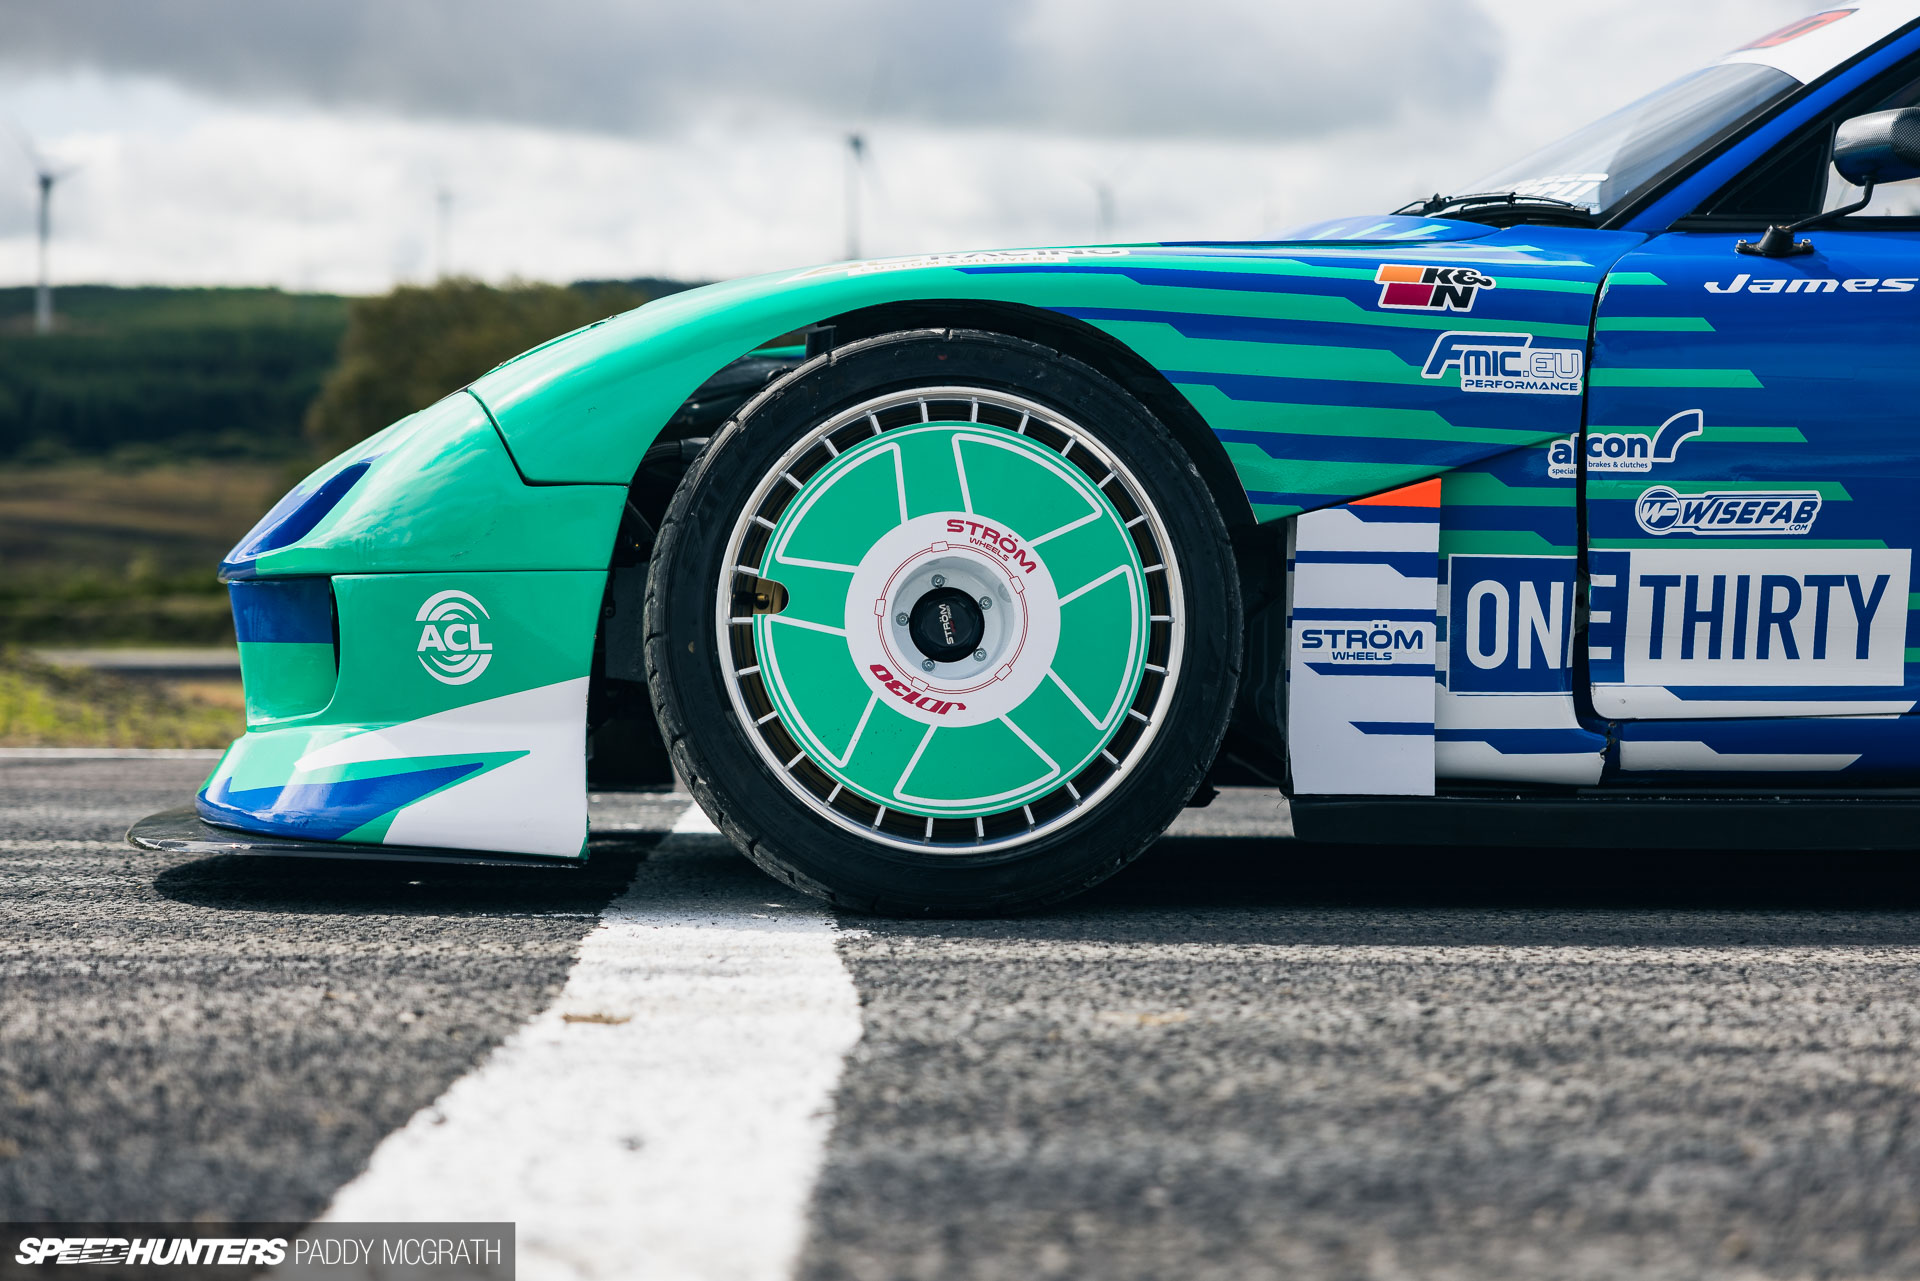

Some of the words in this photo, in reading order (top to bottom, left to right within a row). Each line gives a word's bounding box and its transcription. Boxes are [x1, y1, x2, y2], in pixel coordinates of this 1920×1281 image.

[1704, 274, 1919, 293] James
[1464, 379, 1578, 391] PERFORMANCE
[1620, 461, 1648, 469] clutches
[1682, 500, 1817, 524] WISEFAB
[946, 519, 1037, 574] STRÖM
[969, 537, 1009, 562] WHEELS
[1640, 575, 1890, 660] THIRTY
[417, 623, 493, 652] ACL
[1302, 624, 1423, 649] STRÖM
[1332, 652, 1392, 660] WHEELS
